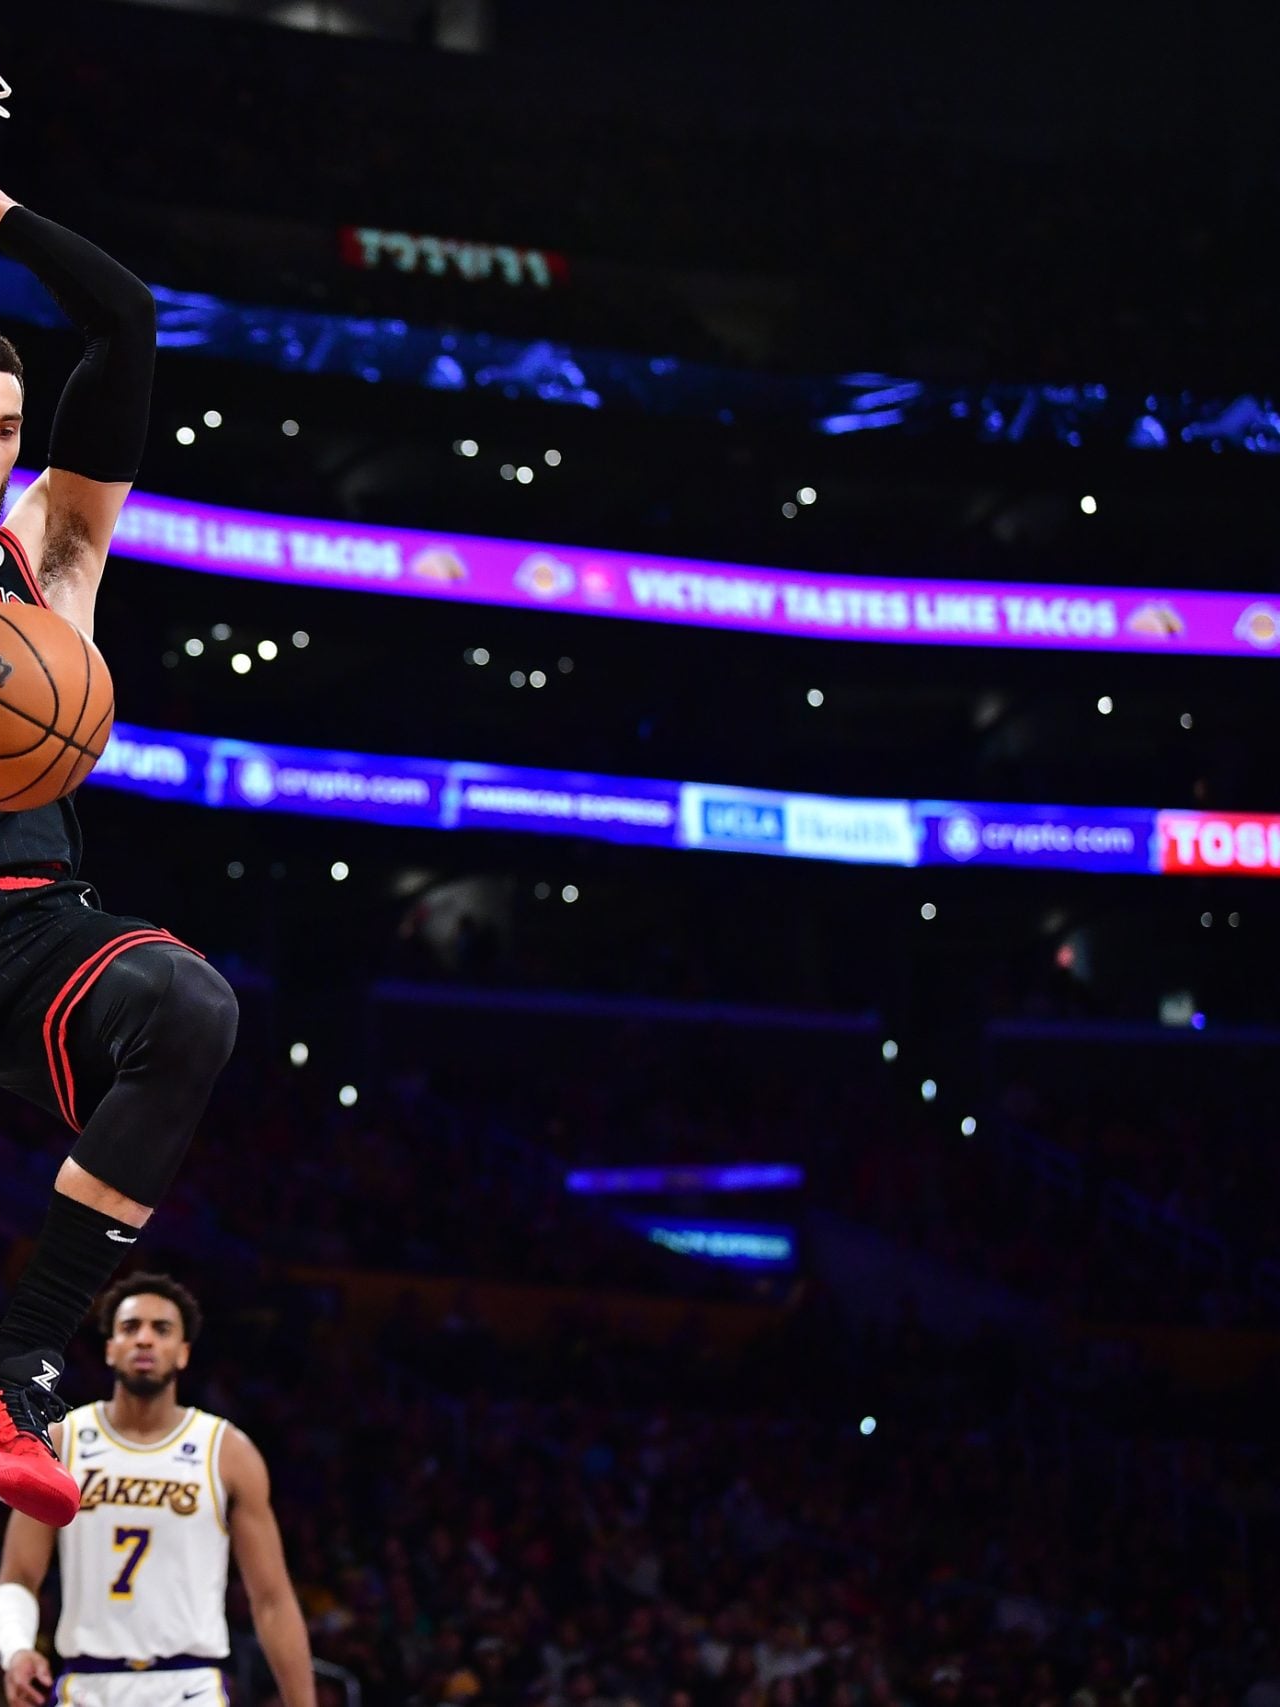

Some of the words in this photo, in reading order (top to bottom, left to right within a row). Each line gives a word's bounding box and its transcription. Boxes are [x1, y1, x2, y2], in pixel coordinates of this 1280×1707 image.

[204, 520, 284, 566] LIKE
[290, 532, 401, 580] TACOS
[628, 569, 775, 621] VICTORY
[783, 584, 908, 630] TASTES
[915, 592, 997, 634] LIKE
[1004, 597, 1117, 639] TACOS
[276, 768, 430, 806] crypto.com
[465, 785, 570, 818] AMERICAN
[576, 793, 672, 827] EXPRESS
[982, 822, 1134, 854] crypto.com
[80, 1468, 200, 1516] LAKERS
[109, 1526, 151, 1603] 7
